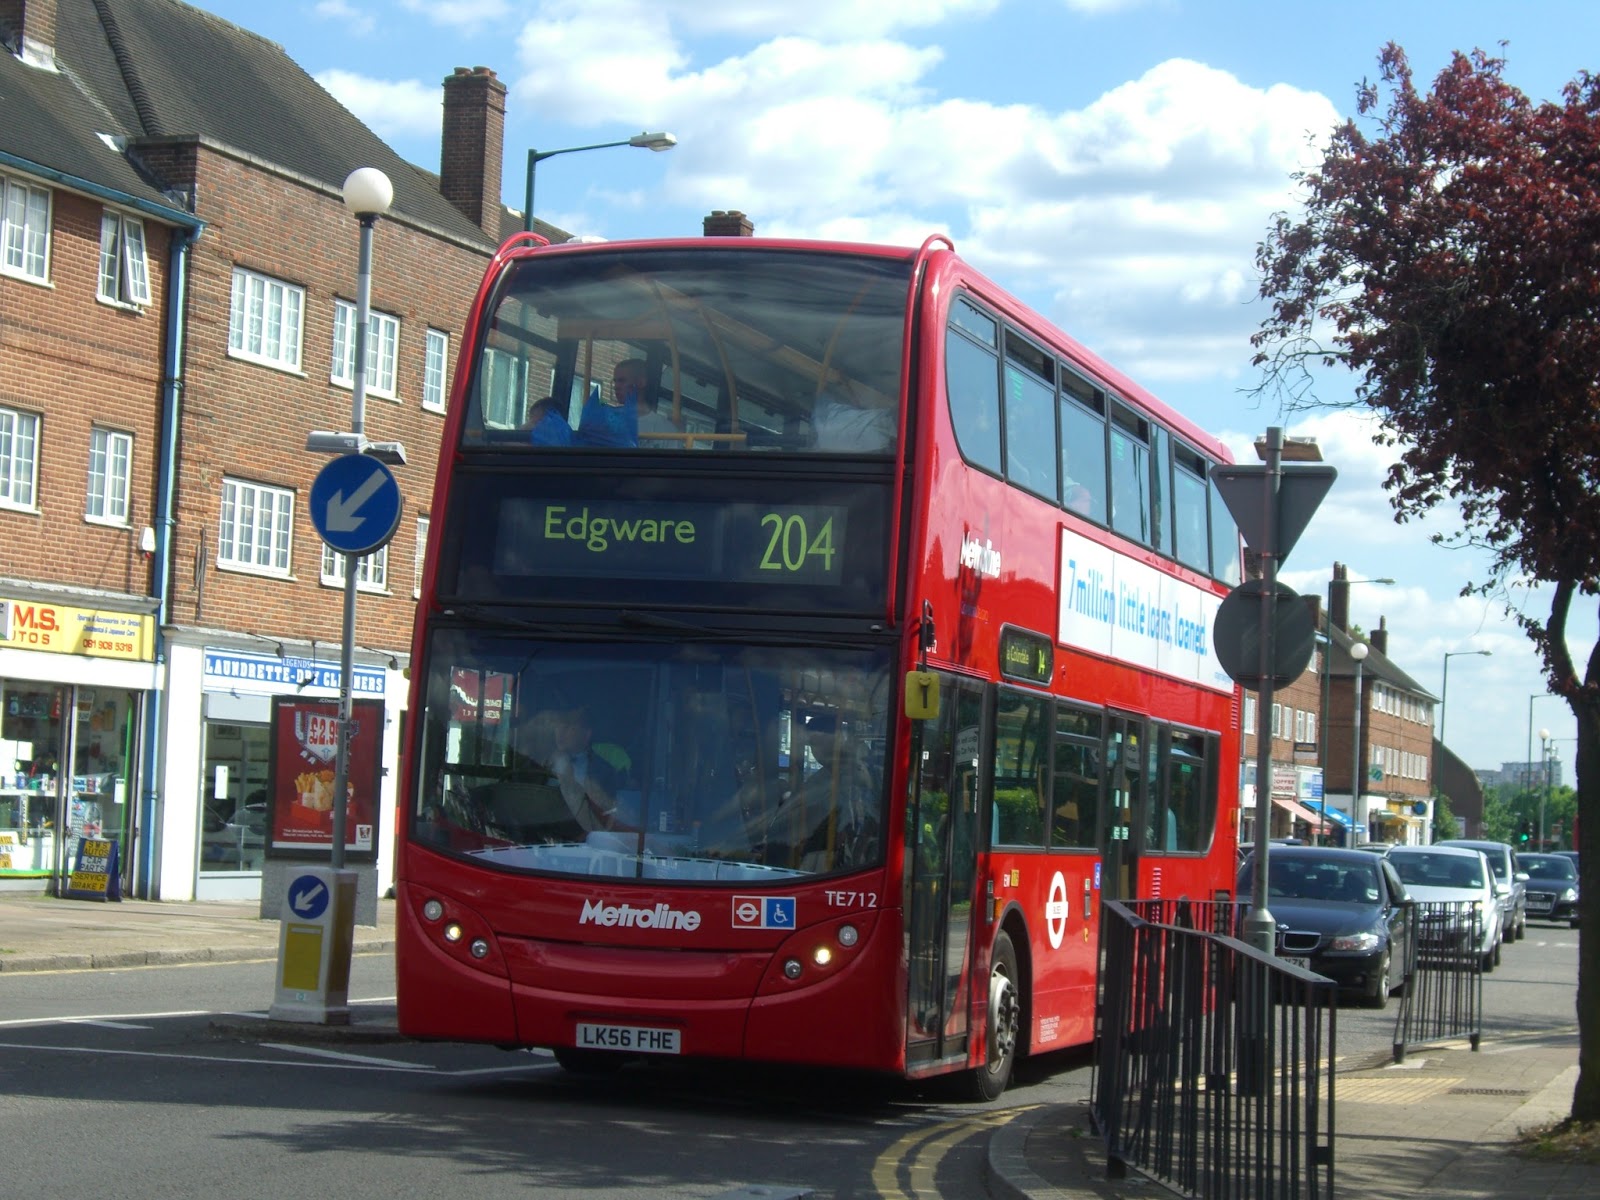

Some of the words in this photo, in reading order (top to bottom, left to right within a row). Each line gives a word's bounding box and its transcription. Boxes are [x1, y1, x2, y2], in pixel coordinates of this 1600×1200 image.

[544, 505, 695, 552] Edgware
[759, 513, 836, 571] 204
[1076, 569, 1115, 625] million
[1119, 580, 1145, 635] little
[98, 640, 113, 650] 908
[282, 658, 311, 669] LEGENDS
[323, 672, 383, 692] CLNERS
[80, 863, 105, 871] PARTS
[71, 881, 97, 890] BRAKE
[74, 872, 107, 881] SERVICE
[825, 890, 877, 908] TE712
[578, 898, 701, 931] Metroline
[583, 1026, 632, 1047] LK56
[637, 1029, 674, 1050] FHE
